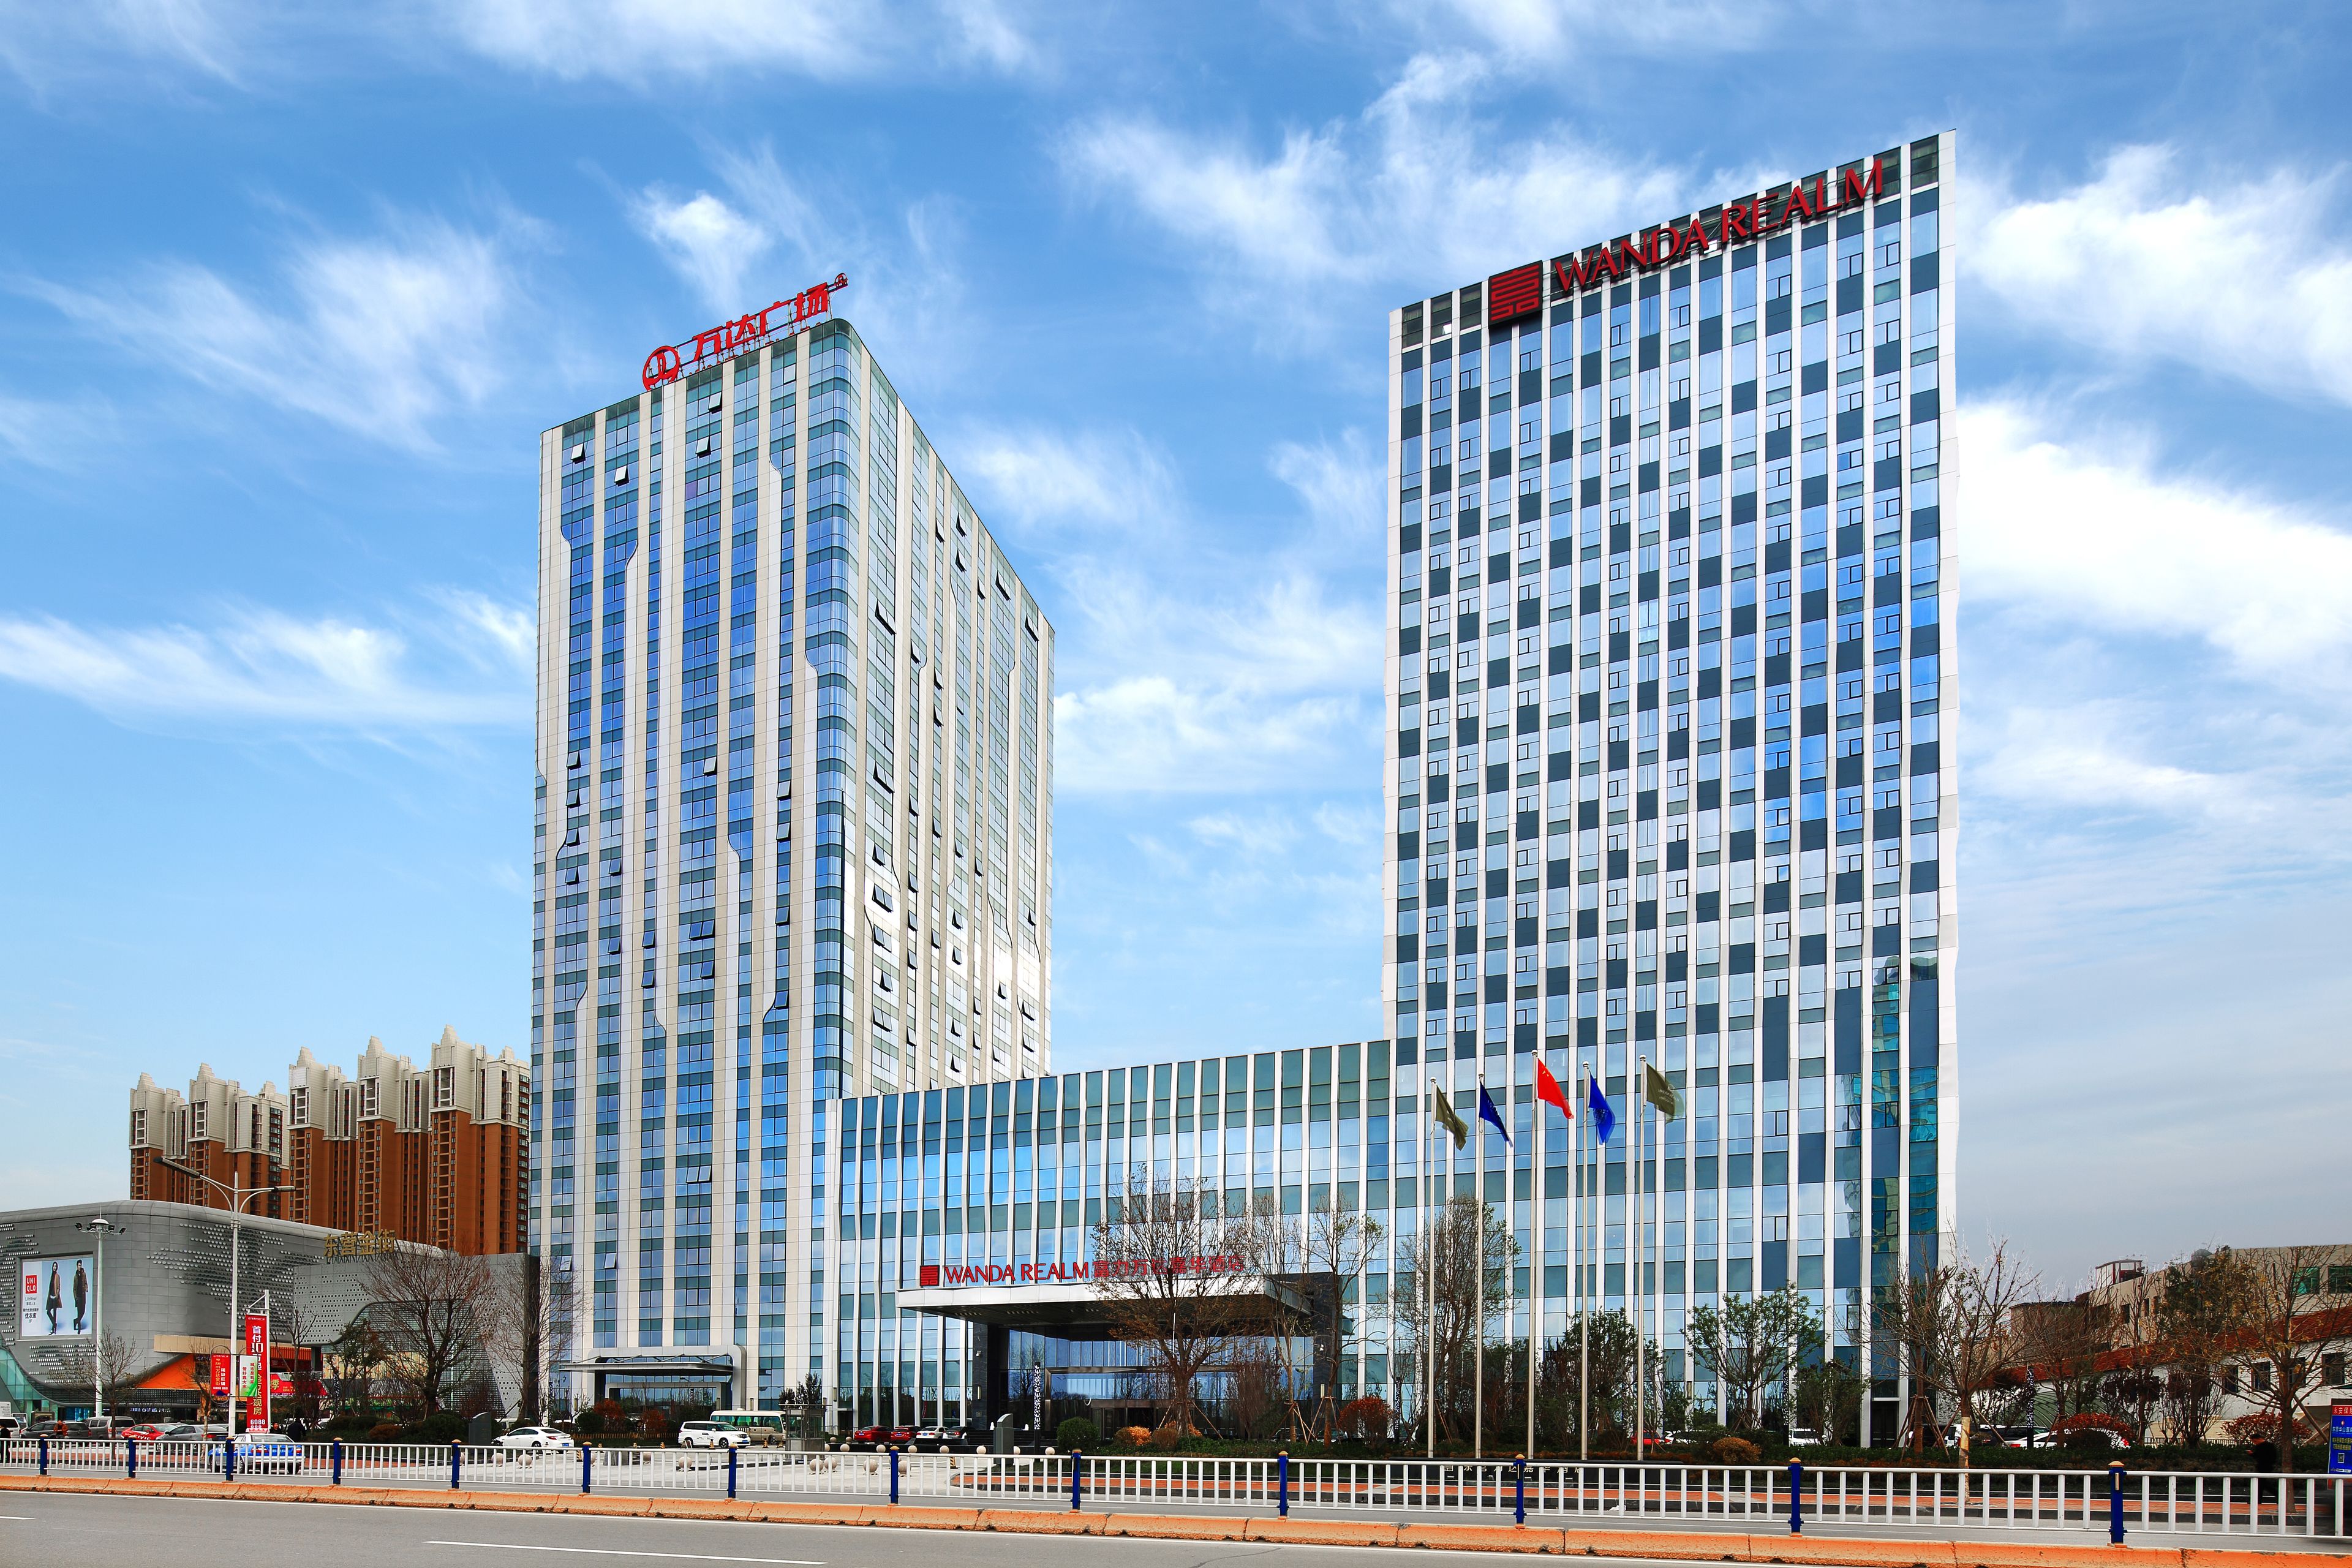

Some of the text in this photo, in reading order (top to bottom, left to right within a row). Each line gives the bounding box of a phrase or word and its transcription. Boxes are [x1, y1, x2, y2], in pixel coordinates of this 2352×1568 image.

[1555, 159, 1882, 292] WANDA REALM
[692, 282, 828, 361] 万达广场
[323, 1229, 396, 1257] 东营金街
[945, 1254, 1245, 1284] WANDA REALM 富力万达嘉华酒店
